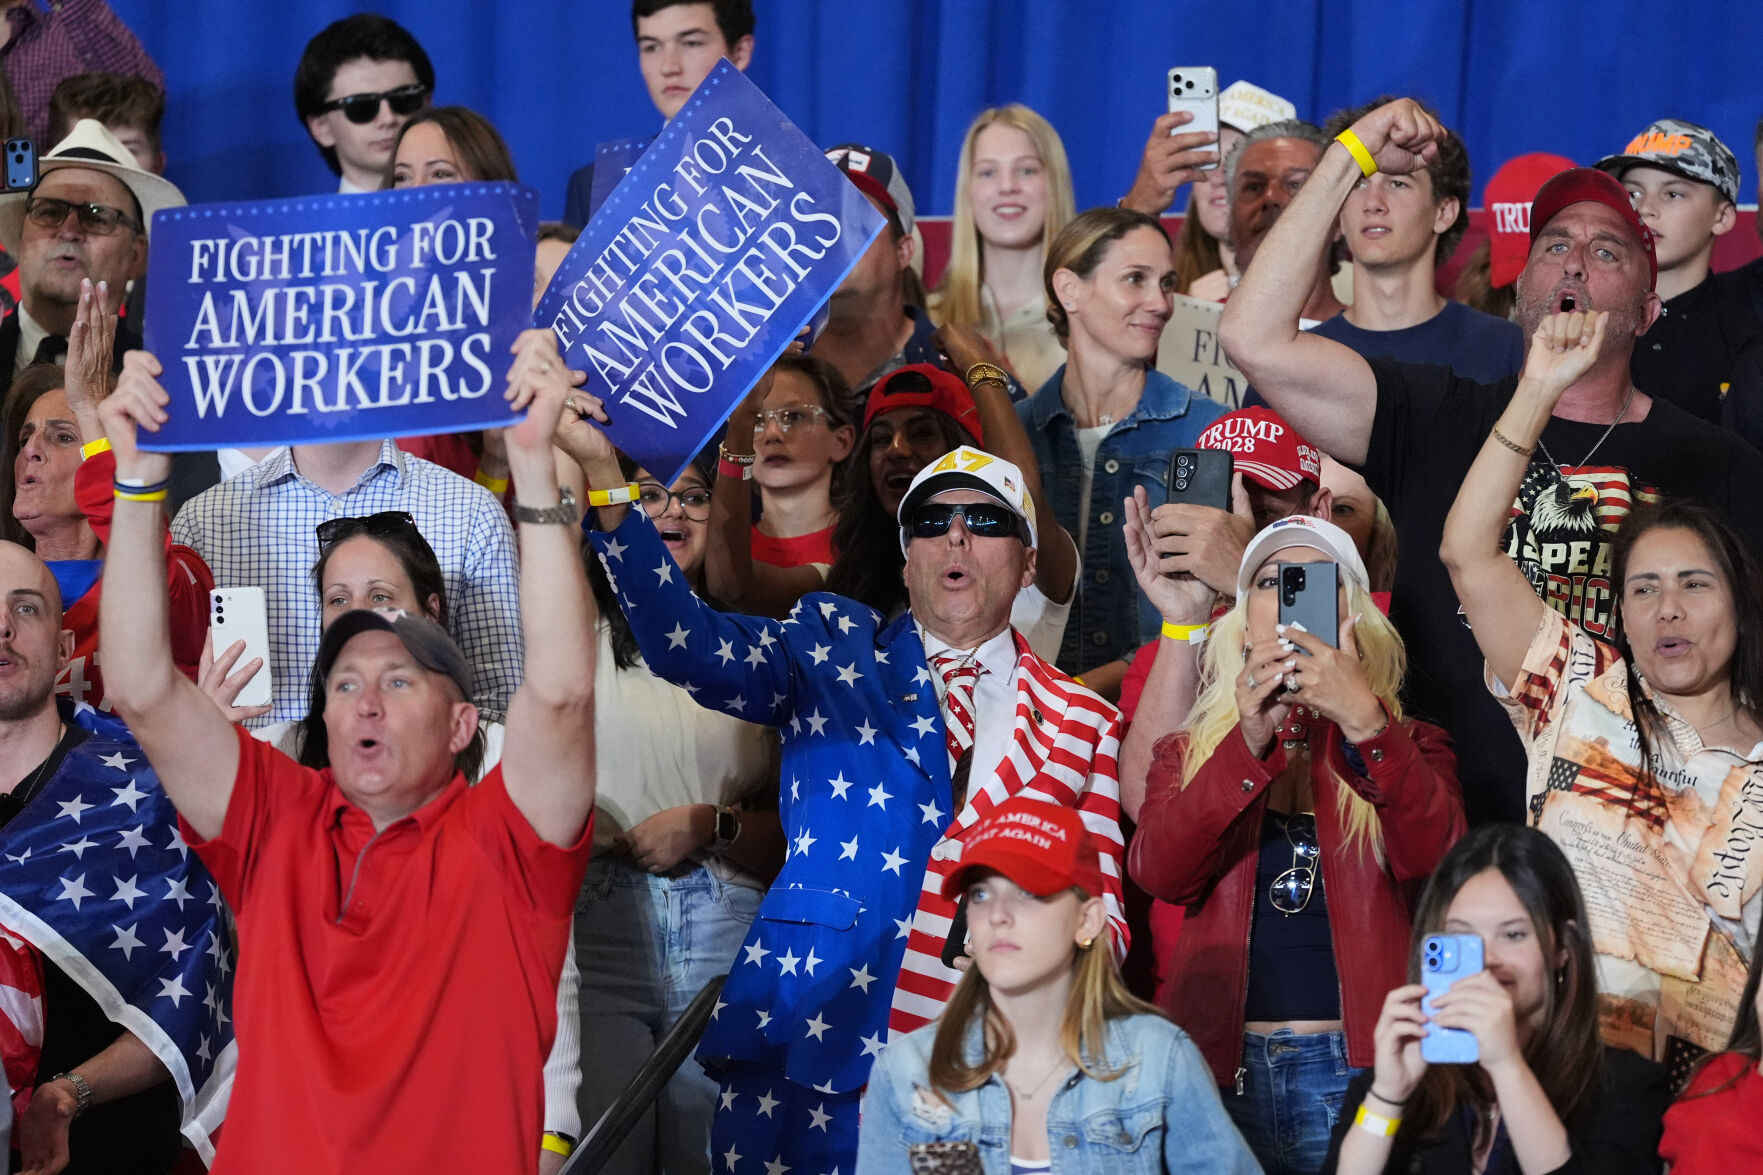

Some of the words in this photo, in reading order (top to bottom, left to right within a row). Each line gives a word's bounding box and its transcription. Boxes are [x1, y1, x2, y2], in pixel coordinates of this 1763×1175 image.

[551, 183, 688, 352] FIGHTING
[673, 116, 752, 195] FOR
[1492, 202, 1533, 233] TRU
[188, 226, 399, 284] FIGHTING
[410, 218, 496, 269] FOR
[583, 145, 794, 394] AMERICAN
[184, 268, 496, 349] AMERICAN
[619, 191, 842, 430] WORKERS
[182, 334, 492, 419] WORKERS
[931, 450, 994, 474] 47
[1198, 417, 1284, 449] TRUMP
[995, 812, 1067, 842] AMERICA
[998, 827, 1052, 850] AGAIN
